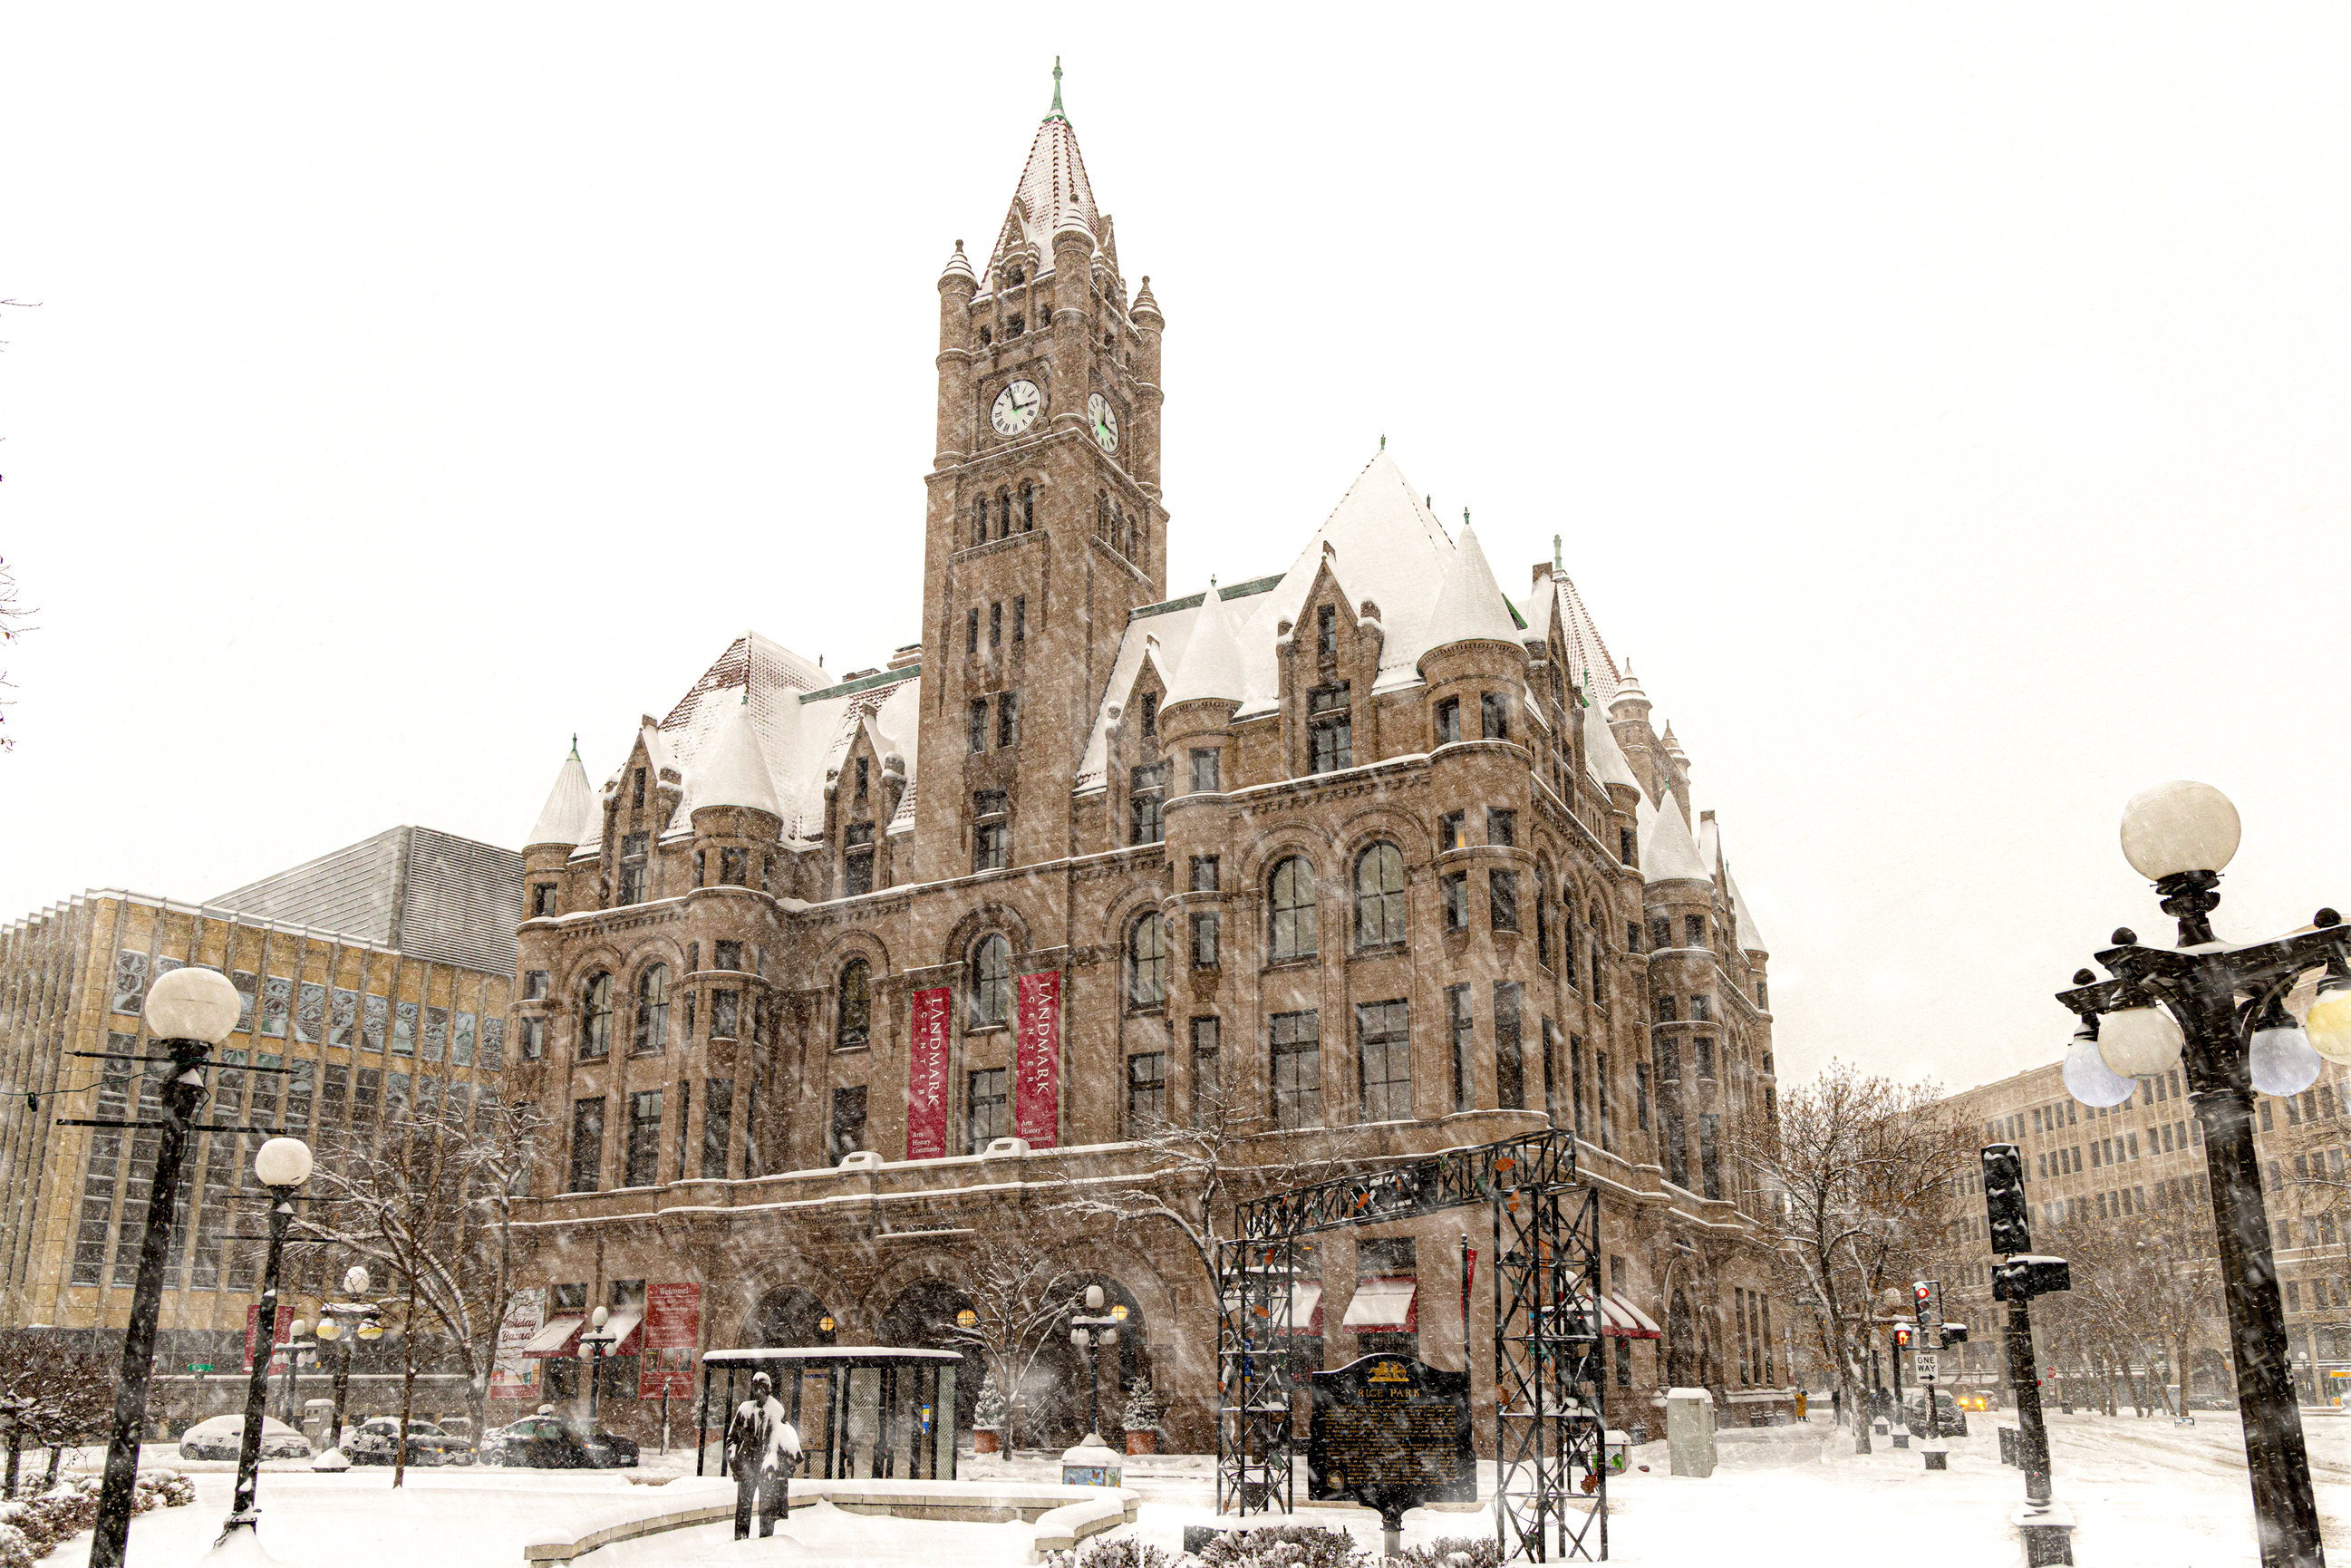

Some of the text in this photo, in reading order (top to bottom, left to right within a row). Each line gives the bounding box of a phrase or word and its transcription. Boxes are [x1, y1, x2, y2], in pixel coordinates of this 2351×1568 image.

[918, 1011, 927, 1095] CENTER
[928, 998, 944, 1106] LANDMARK
[1038, 982, 1052, 1095] LANDMARK
[502, 1331, 536, 1341] Bazaar
[504, 1318, 537, 1331] Holiday
[1358, 1389, 1420, 1398] RICE PARK
